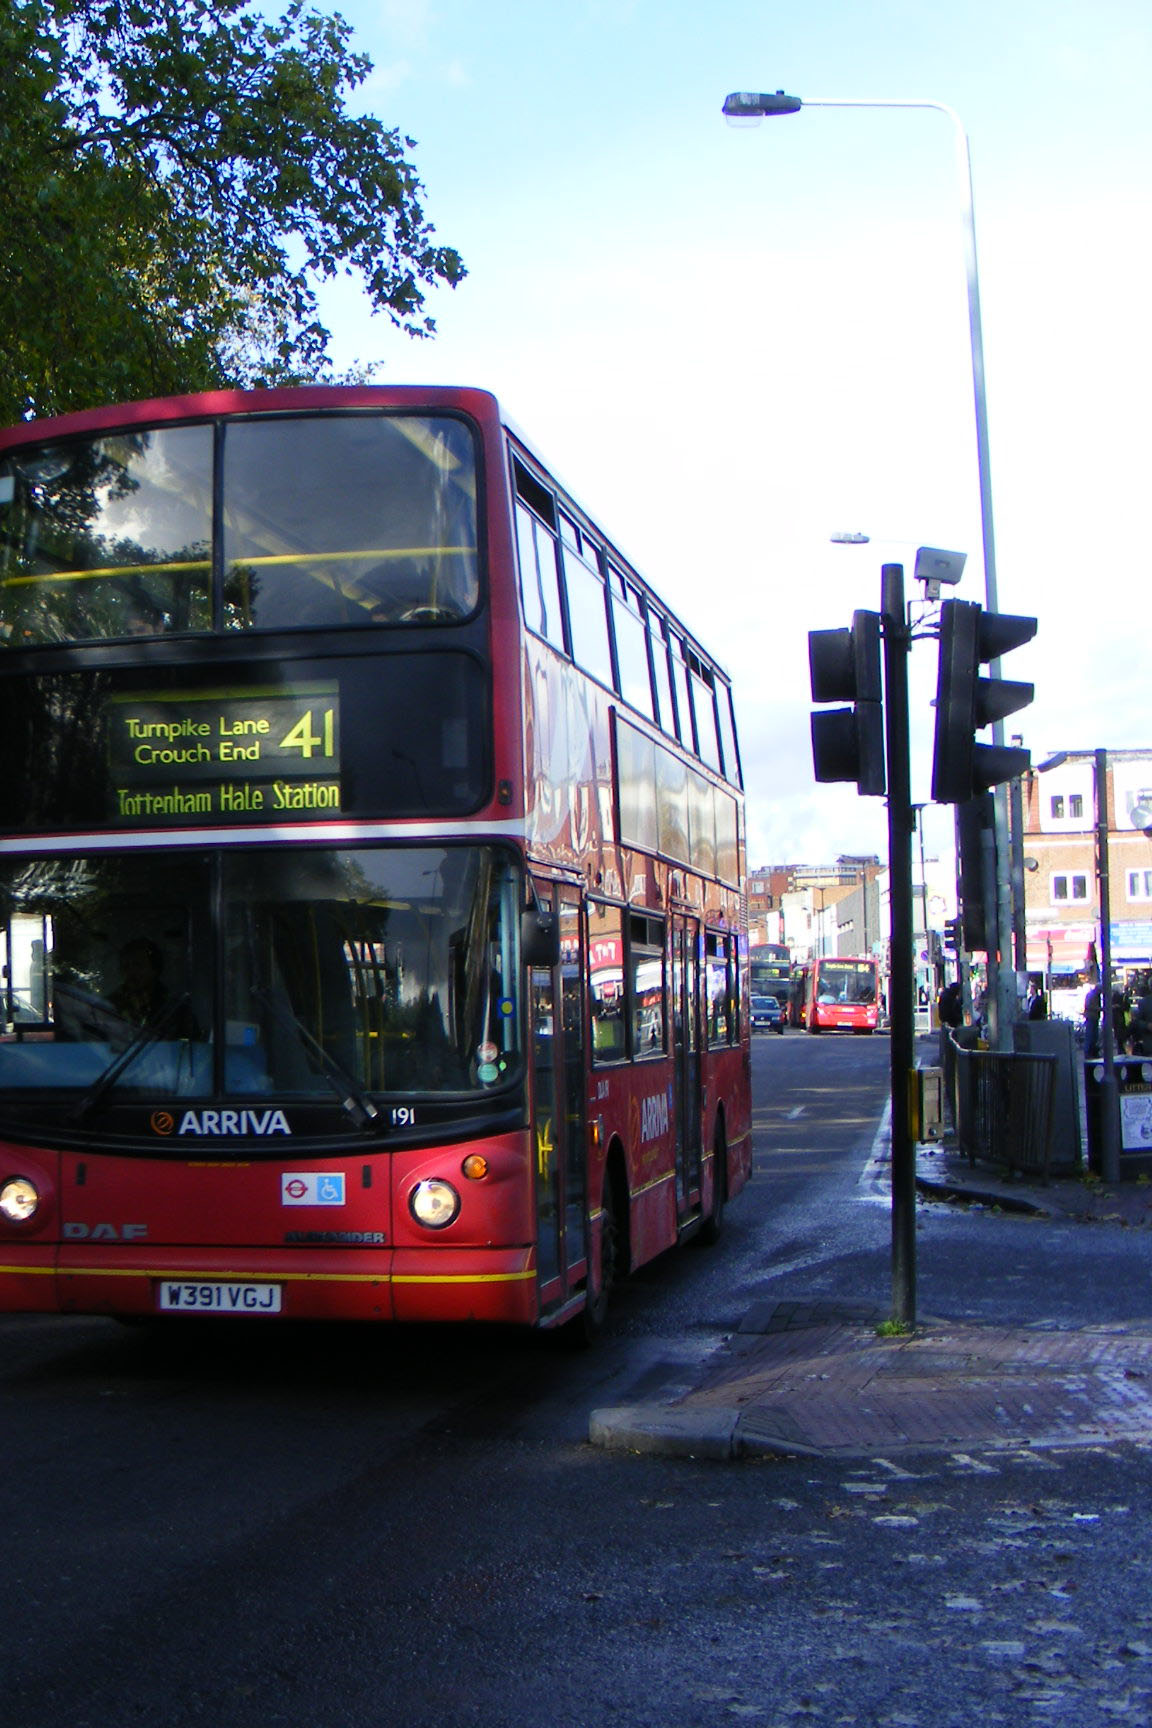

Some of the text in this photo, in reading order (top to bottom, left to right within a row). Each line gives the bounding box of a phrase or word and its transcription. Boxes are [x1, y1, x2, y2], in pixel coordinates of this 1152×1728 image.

[125, 716, 270, 743] Turnpike Lane
[279, 709, 334, 758] 41
[134, 741, 260, 764] Crouch End
[117, 780, 339, 815] Tottenham Hale Station
[178, 1110, 293, 1135] ARRIVA
[392, 1108, 415, 1126] 191
[641, 1092, 669, 1144] ARRIVA
[63, 1222, 148, 1240] DAF
[168, 1285, 273, 1309] W391 VGJ
